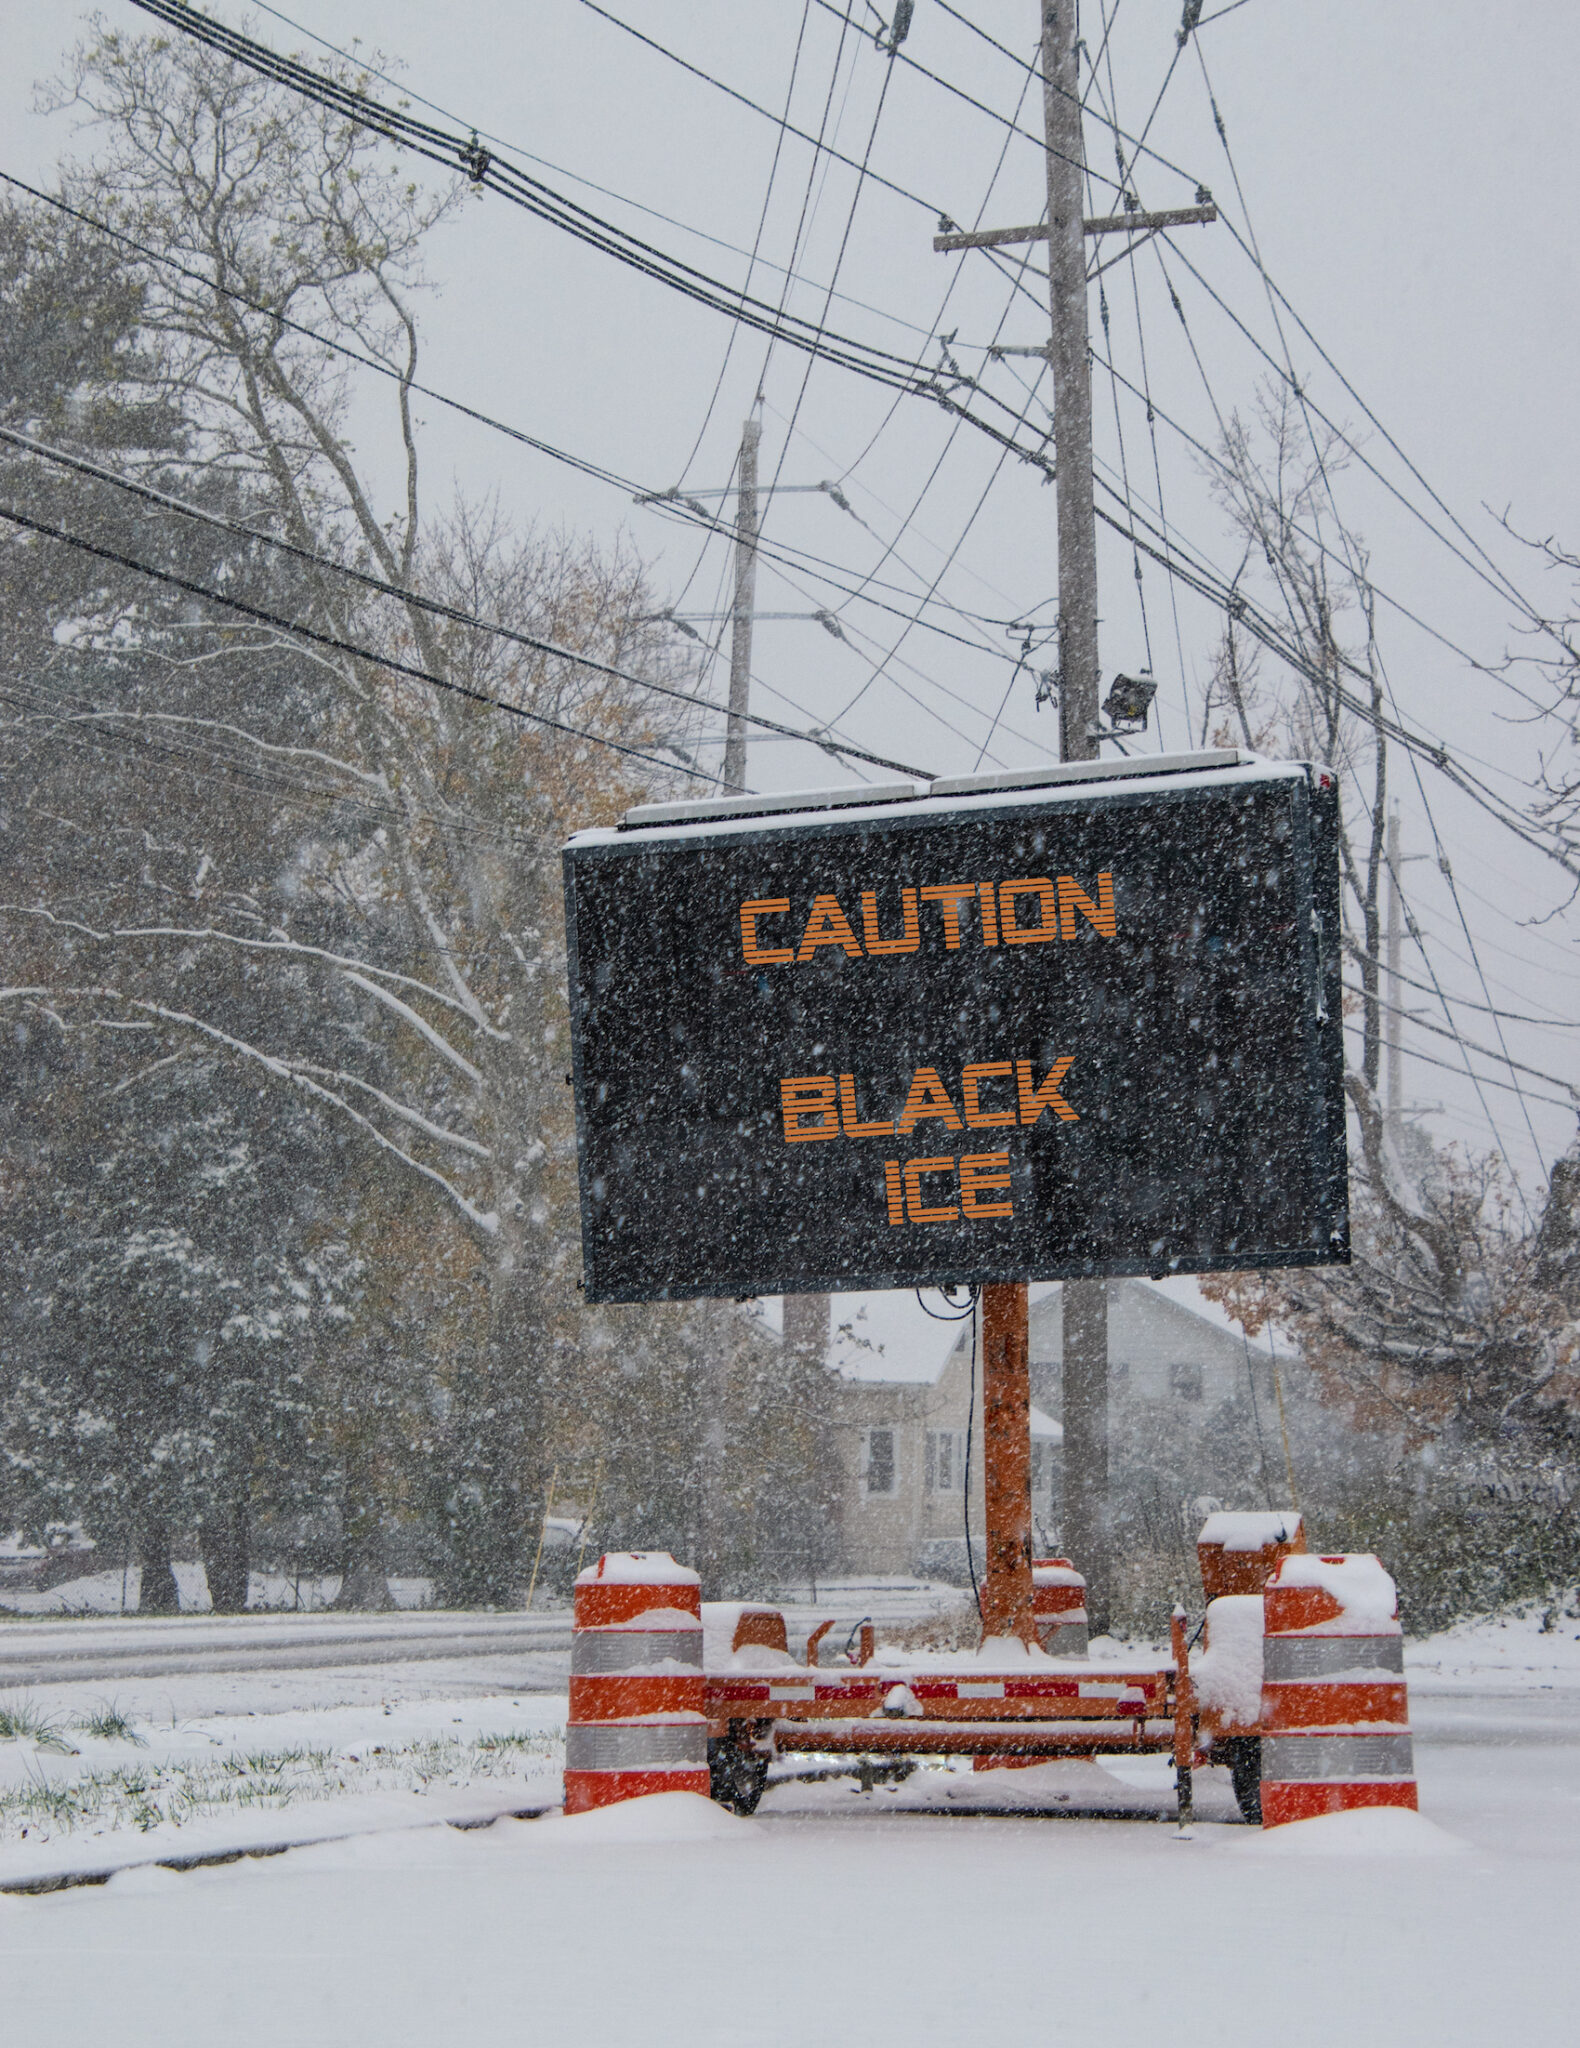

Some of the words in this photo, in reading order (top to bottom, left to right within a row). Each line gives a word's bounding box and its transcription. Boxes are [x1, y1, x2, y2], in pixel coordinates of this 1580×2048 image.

[740, 873, 1117, 965] CAUTION
[780, 1056, 1080, 1143] BLACK
[885, 1152, 1013, 1226] ICE
